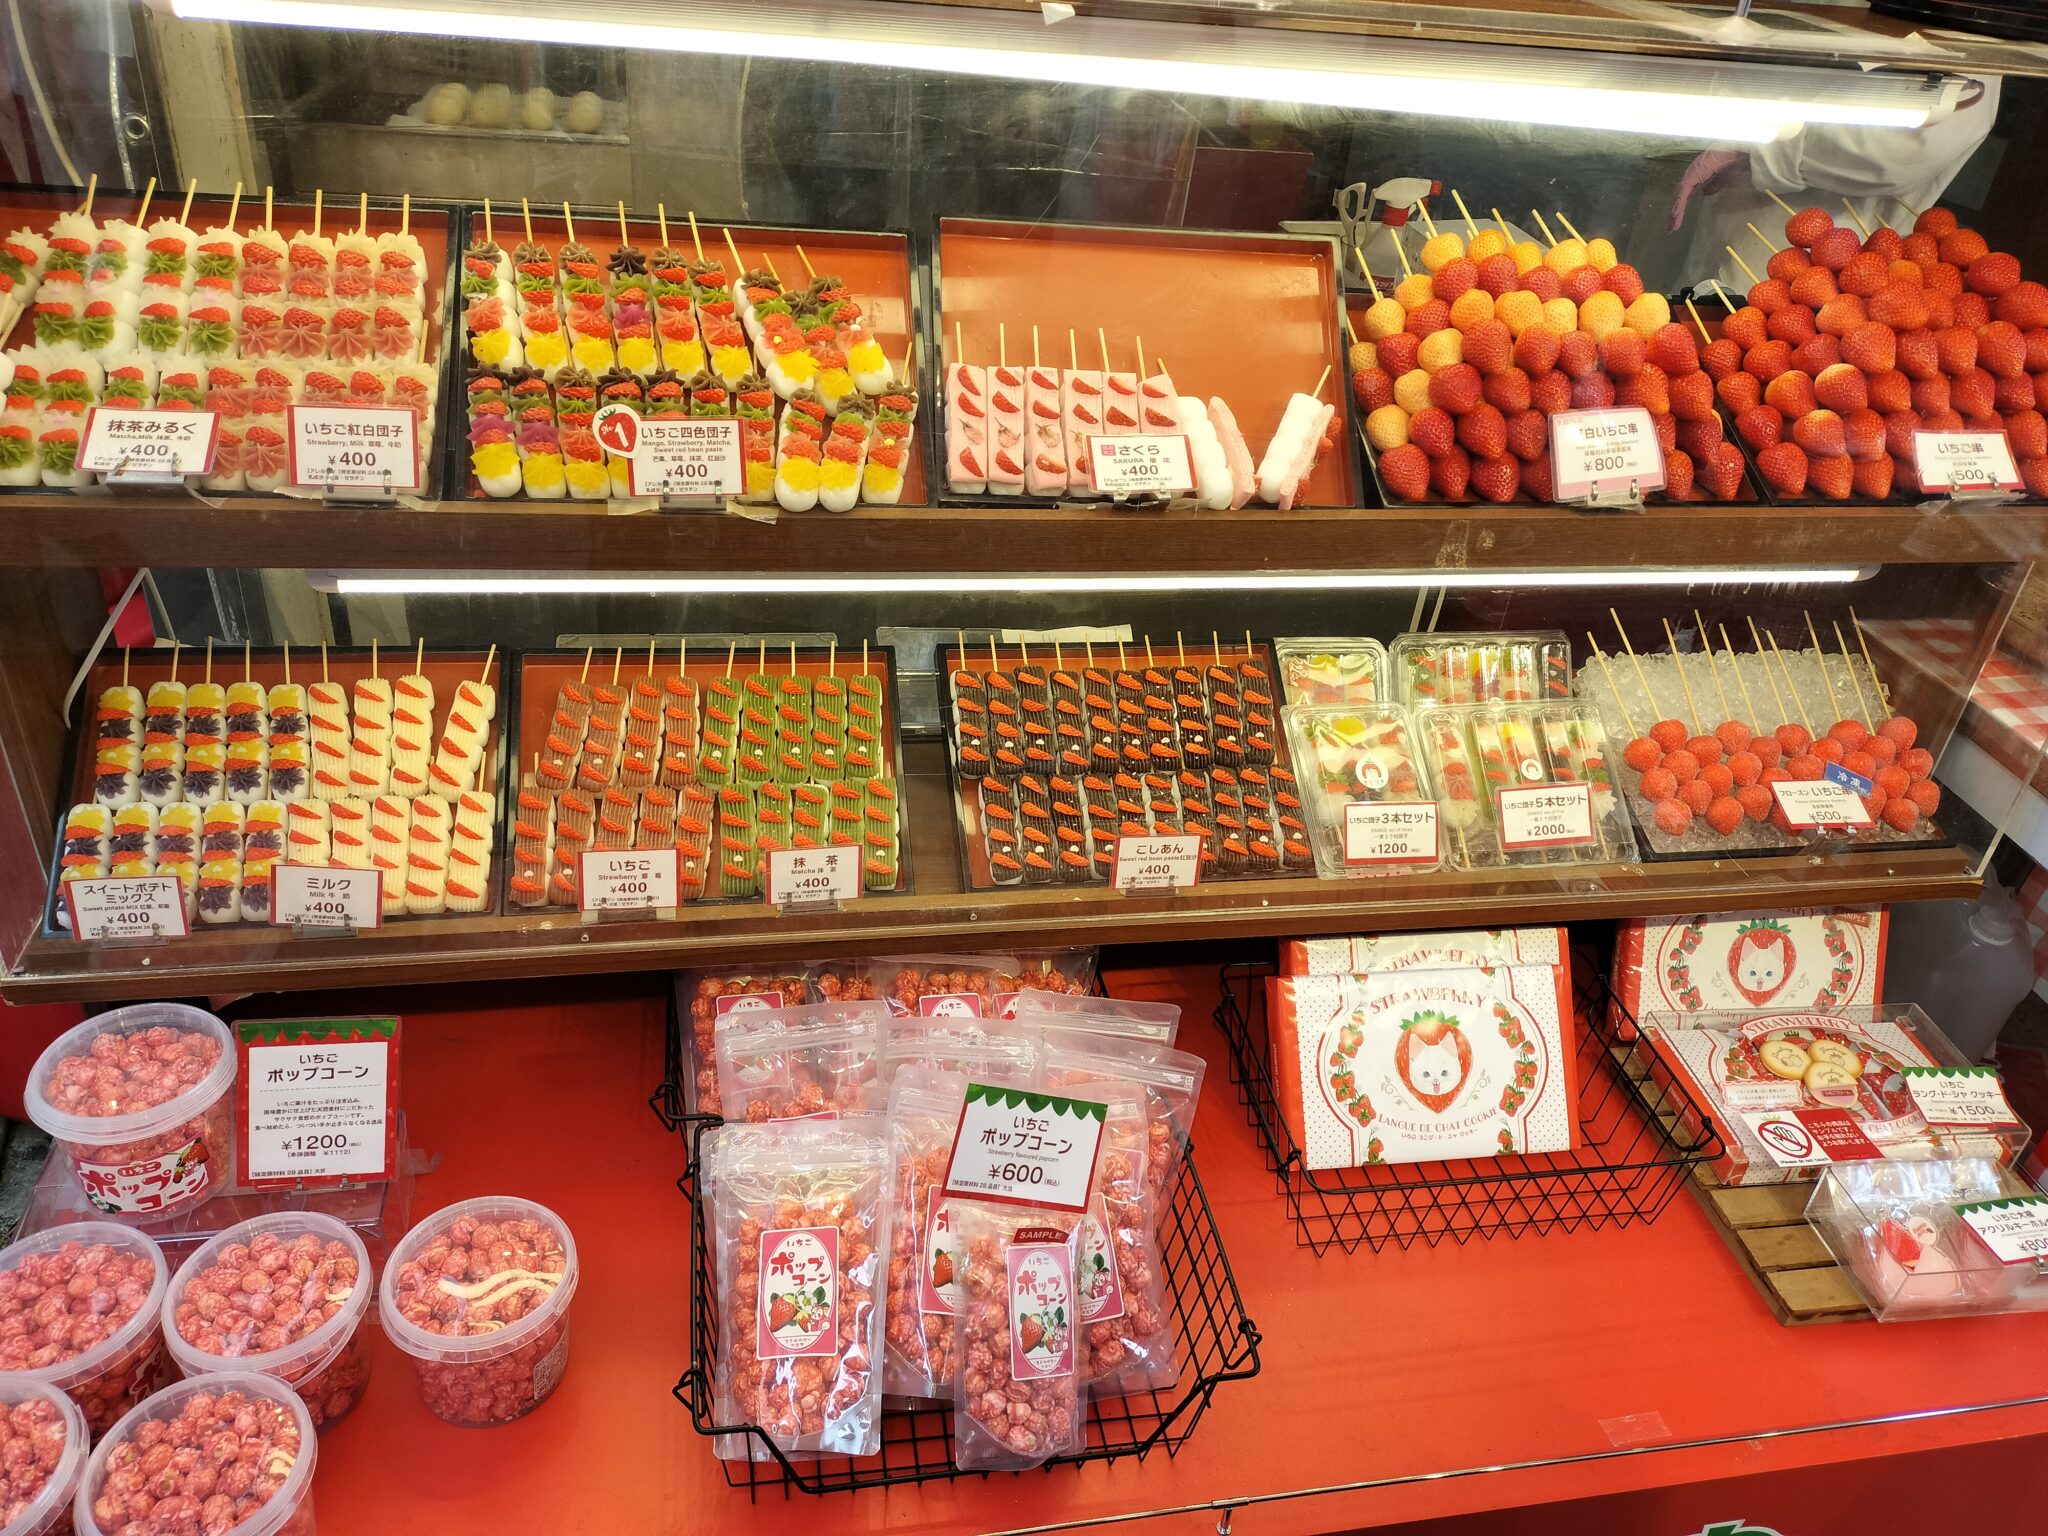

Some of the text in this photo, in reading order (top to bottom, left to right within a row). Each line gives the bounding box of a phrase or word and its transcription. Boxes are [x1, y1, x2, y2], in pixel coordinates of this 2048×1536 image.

[107, 419, 197, 434] 抹茶みるく
[305, 422, 404, 438] いちご紅白団子
[641, 426, 733, 439] いちご四色団子
[1578, 423, 1639, 439] 白いちご串
[120, 444, 169, 456] ¥400
[1118, 444, 1160, 456] さくら
[1937, 442, 1984, 454] いちご串
[328, 452, 376, 466] ¥400
[1583, 455, 1624, 472] ¥800
[665, 464, 708, 478] ¥400
[1121, 465, 1159, 476] ¥400
[1946, 469, 1985, 480] ¥500
[1808, 811, 1841, 821] ¥500
[1526, 824, 1566, 836] ¥2000
[1136, 843, 1184, 855] こしあん
[1370, 843, 1408, 854] ¥1200
[609, 860, 651, 871] いちご
[1138, 864, 1170, 875] ¥400
[83, 882, 172, 895] スイートポテト
[306, 877, 352, 890] ミルク
[610, 882, 648, 893] ¥400
[795, 877, 830, 889] ¥400
[105, 893, 156, 904] ミックス
[305, 902, 345, 914] ¥400
[106, 912, 150, 924] ¥400
[1745, 1016, 1852, 1035] STRAWBERRY
[299, 1053, 339, 1064] いちご
[267, 1066, 369, 1083] ポップコーン
[1970, 1090, 2003, 1099] クッキー
[1949, 1105, 1995, 1116] ¥1500
[1013, 1115, 1050, 1132] いちご
[1378, 1106, 1497, 1133] LANGUE DE CHAT COOKIE
[281, 1134, 348, 1151] ¥1200
[980, 1127, 1073, 1154] ポップコーン
[988, 1148, 1059, 1163] Strawberry flavoured popcorn
[121, 1163, 159, 1176] いちご
[988, 1162, 1043, 1184] ¥600
[80, 1168, 172, 1198] ポップ
[135, 1171, 208, 1211] コーン
[1978, 1218, 2048, 1235] アクリルキーホル
[1018, 1231, 1064, 1240] SAMPLE
[787, 1238, 813, 1247] いちご
[770, 1252, 825, 1276] ポップ
[1028, 1256, 1050, 1265] いちご
[792, 1274, 831, 1287] コーン
[1017, 1270, 1061, 1296] ポップ
[1036, 1292, 1067, 1307] コーン
